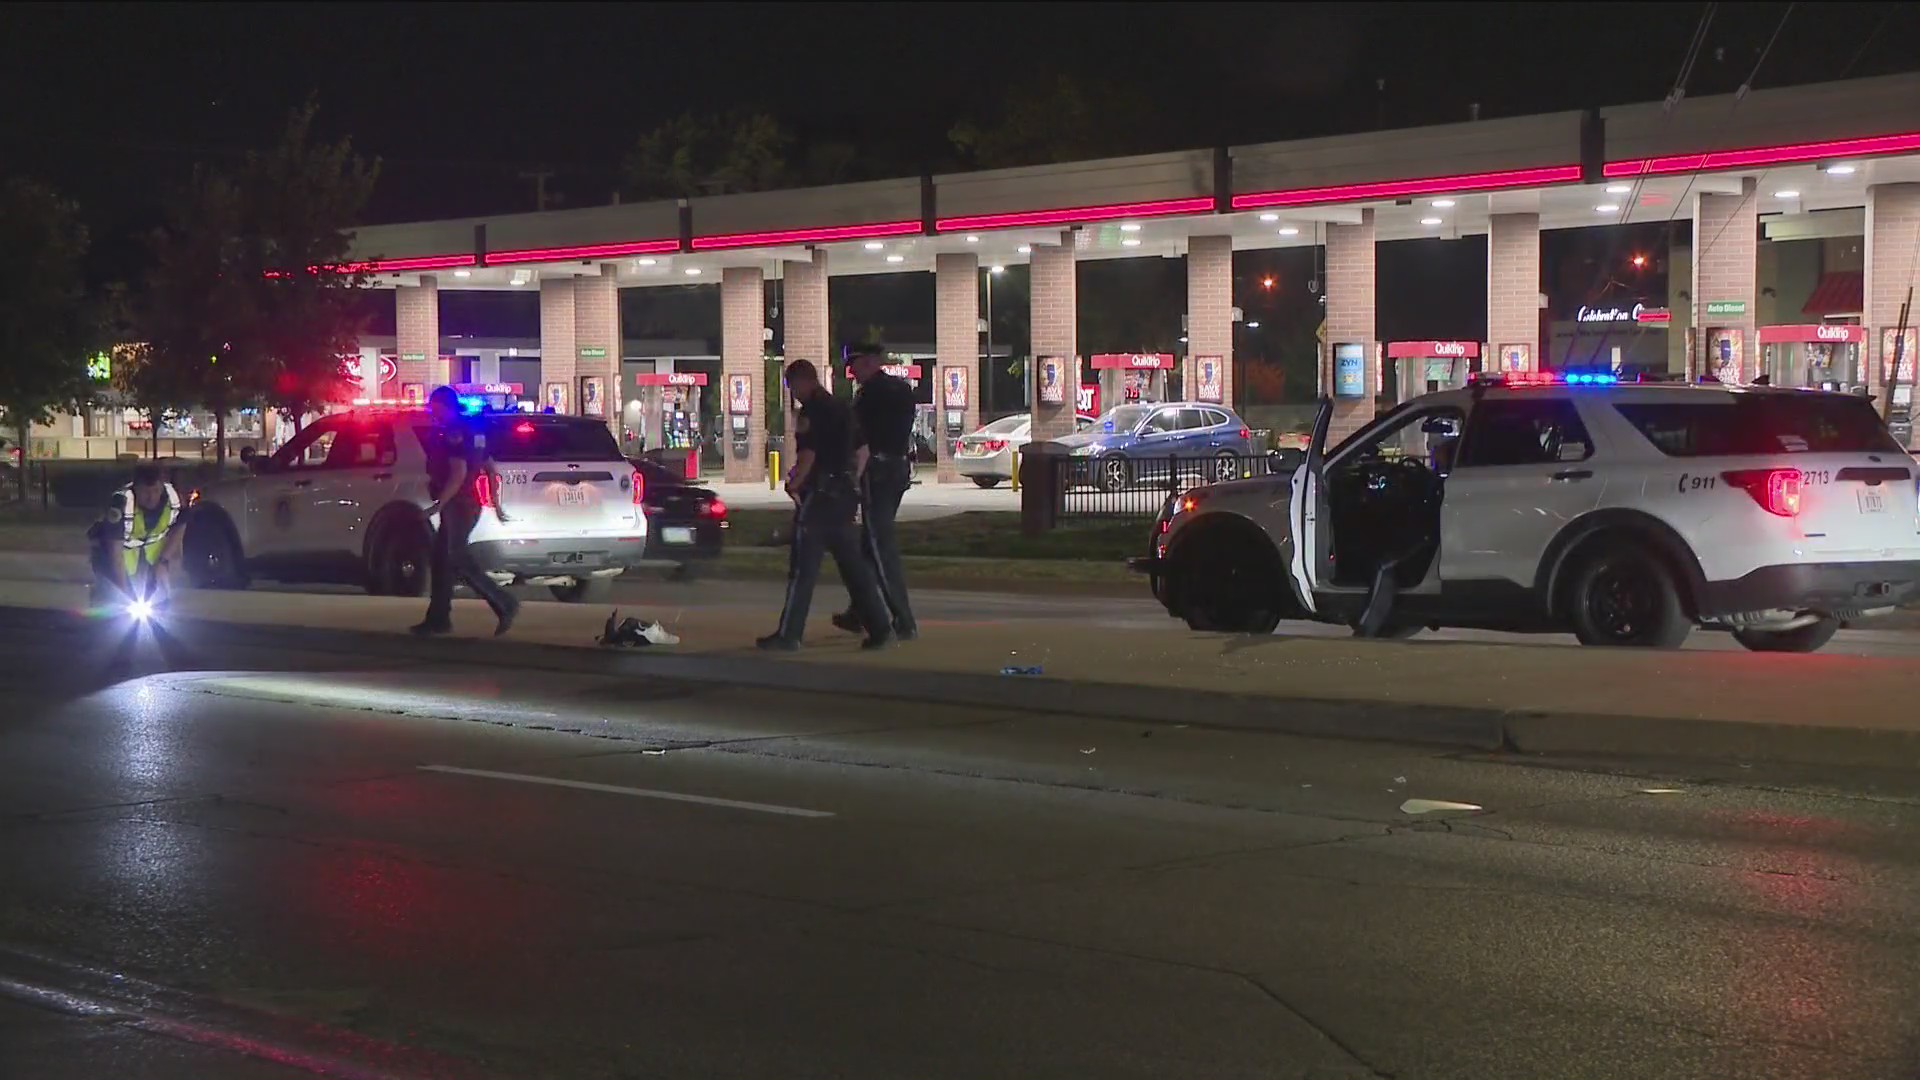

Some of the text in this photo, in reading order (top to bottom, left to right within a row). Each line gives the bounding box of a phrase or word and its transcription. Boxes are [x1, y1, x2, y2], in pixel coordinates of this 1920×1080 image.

[1707, 304, 1744, 312] Auto Diesel
[1817, 326, 1848, 341] QuikTrip
[1435, 341, 1465, 356] QuikTrip
[1132, 355, 1160, 368] QuikTrip
[669, 374, 695, 385] QuikTrip
[485, 383, 512, 394] QuikTrip
[506, 474, 527, 484] 2763
[1691, 476, 1716, 489] 911
[1804, 470, 1829, 485] 2713
